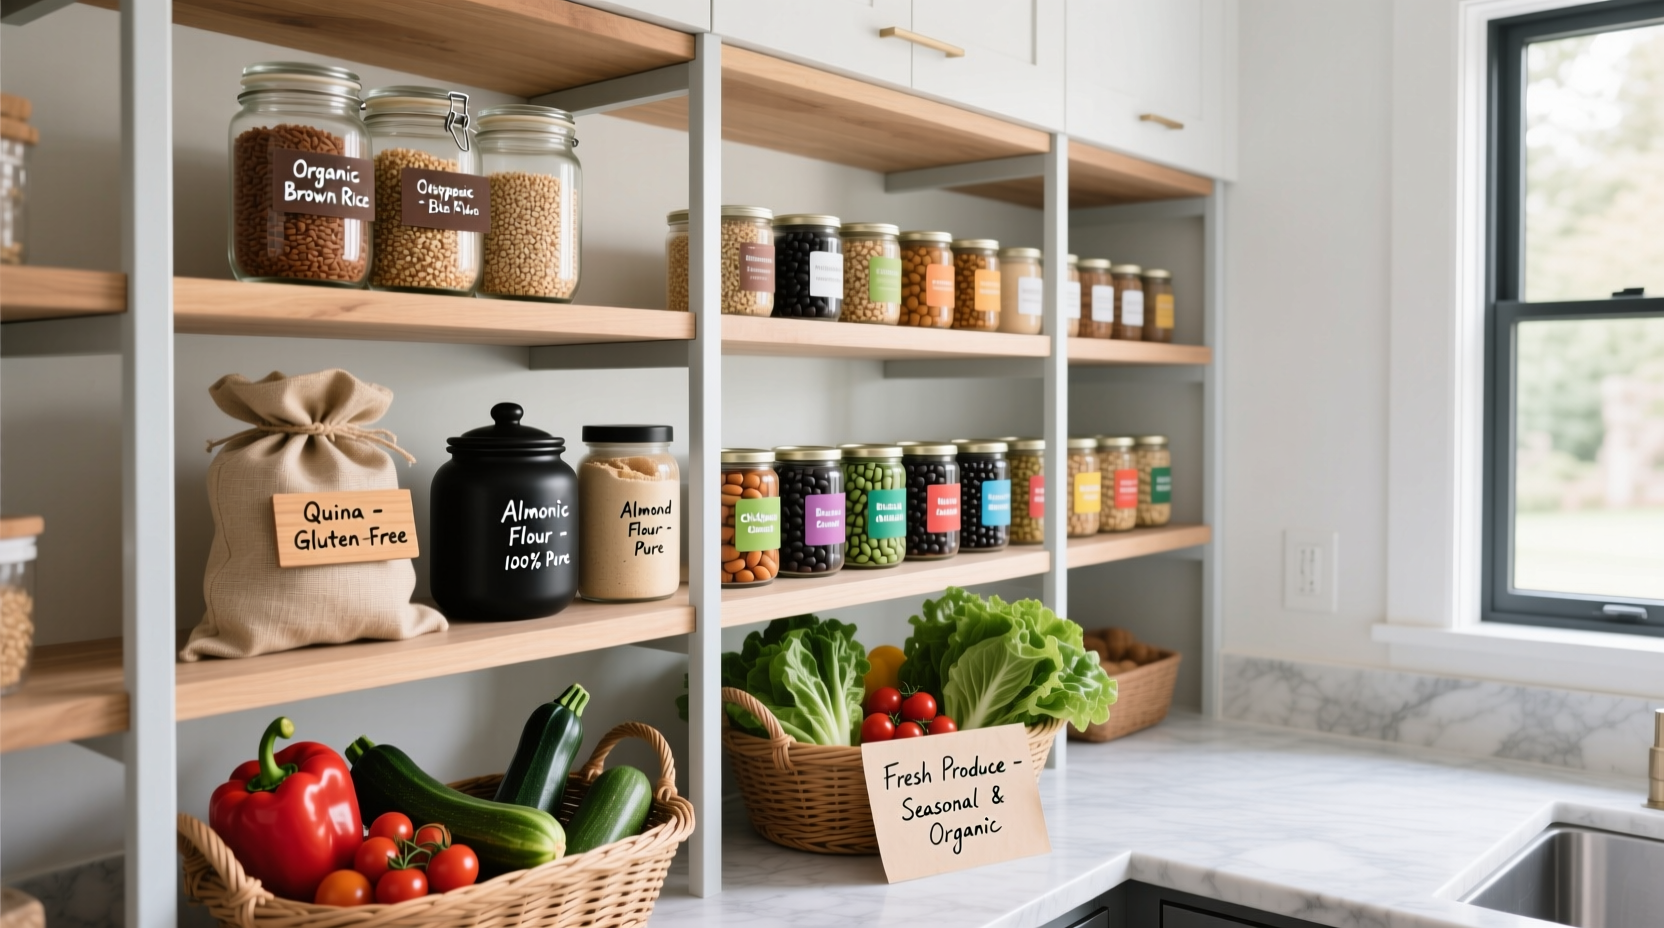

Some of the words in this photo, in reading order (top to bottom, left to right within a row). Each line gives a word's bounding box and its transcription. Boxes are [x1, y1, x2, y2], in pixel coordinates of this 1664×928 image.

[293, 159, 360, 188] Organic
[284, 181, 336, 205] Brown
[341, 187, 369, 208] Rice
[303, 501, 365, 524] Quina
[500, 499, 570, 523] Almonic
[620, 499, 672, 519] Almond
[509, 525, 553, 547] Flour
[628, 521, 663, 537] Flour
[634, 540, 664, 556] Pure
[504, 551, 542, 571] 100%
[883, 761, 932, 790] Fresh
[942, 755, 1006, 781] Produce
[902, 787, 979, 821] Seasonal
[991, 785, 1005, 804] &
[929, 817, 1003, 855] Organic
